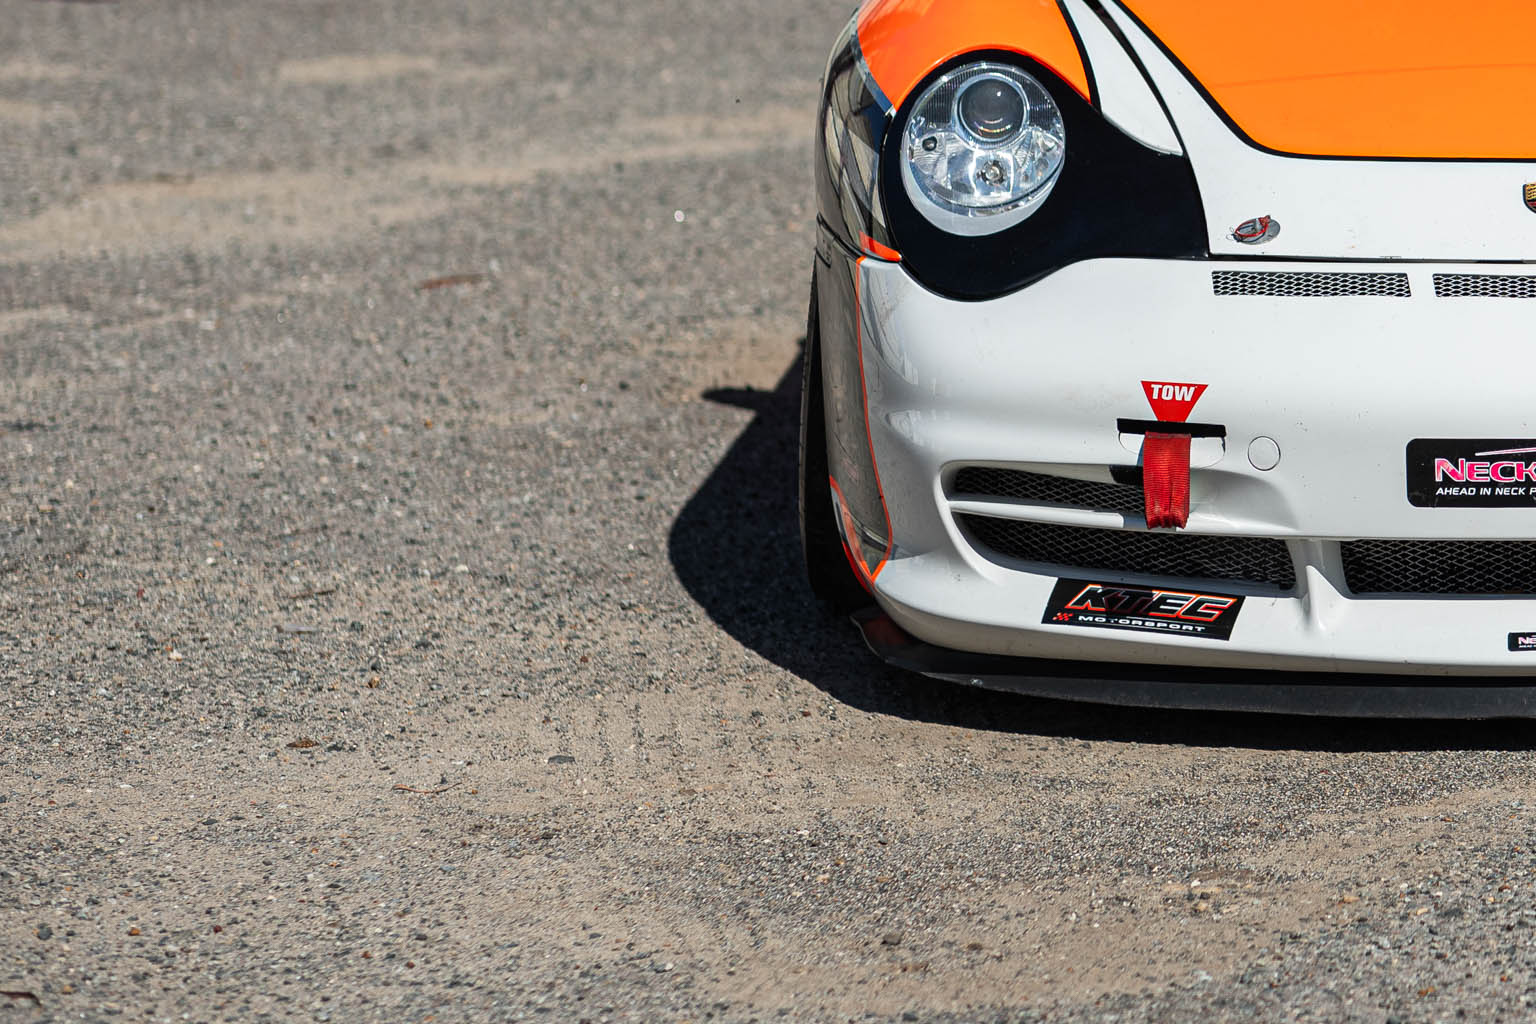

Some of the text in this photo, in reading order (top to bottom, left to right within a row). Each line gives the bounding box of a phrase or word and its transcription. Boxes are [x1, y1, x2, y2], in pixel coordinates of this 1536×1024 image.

[1150, 383, 1196, 402] TOW
[1435, 487, 1476, 496] AHEAD
[1479, 487, 1492, 496] IN
[1495, 487, 1526, 496] NECK
[1064, 583, 1238, 622] KTEC
